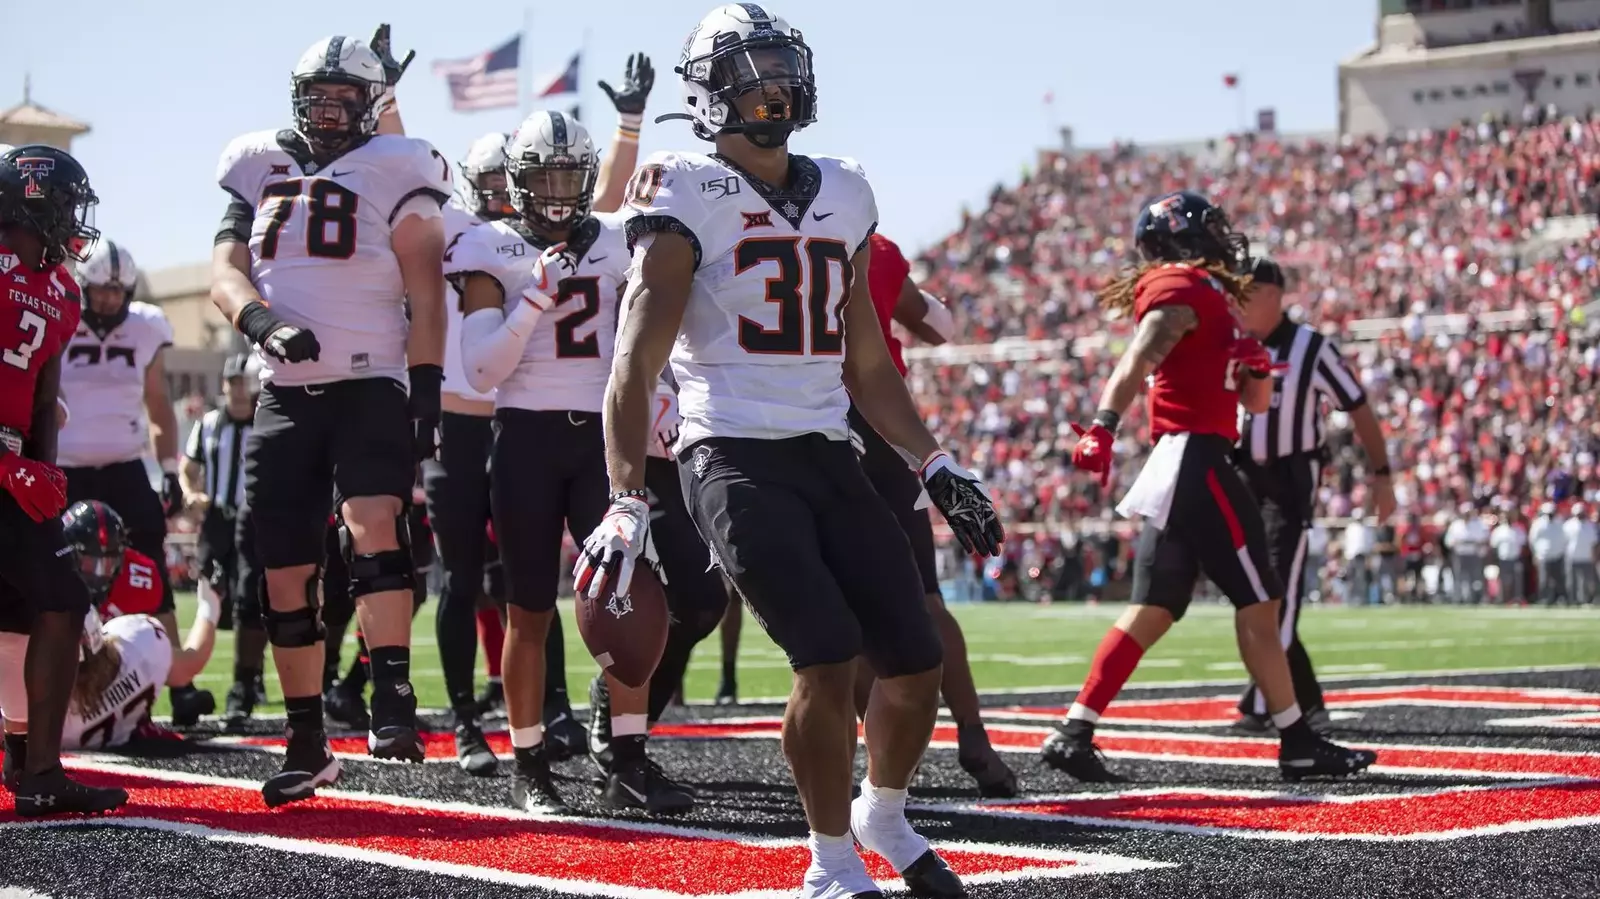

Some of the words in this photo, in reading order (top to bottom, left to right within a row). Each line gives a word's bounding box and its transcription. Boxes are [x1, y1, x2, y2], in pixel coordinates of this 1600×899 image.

[700, 175, 741, 200] 150
[257, 178, 360, 261] 78
[740, 210, 775, 232] XII
[496, 241, 525, 257] 150
[8, 288, 39, 309] TEXAS
[41, 301, 61, 321] TECH
[734, 236, 852, 356] 30
[554, 276, 602, 359] 2
[2, 309, 47, 371] 3
[129, 562, 153, 590] 97
